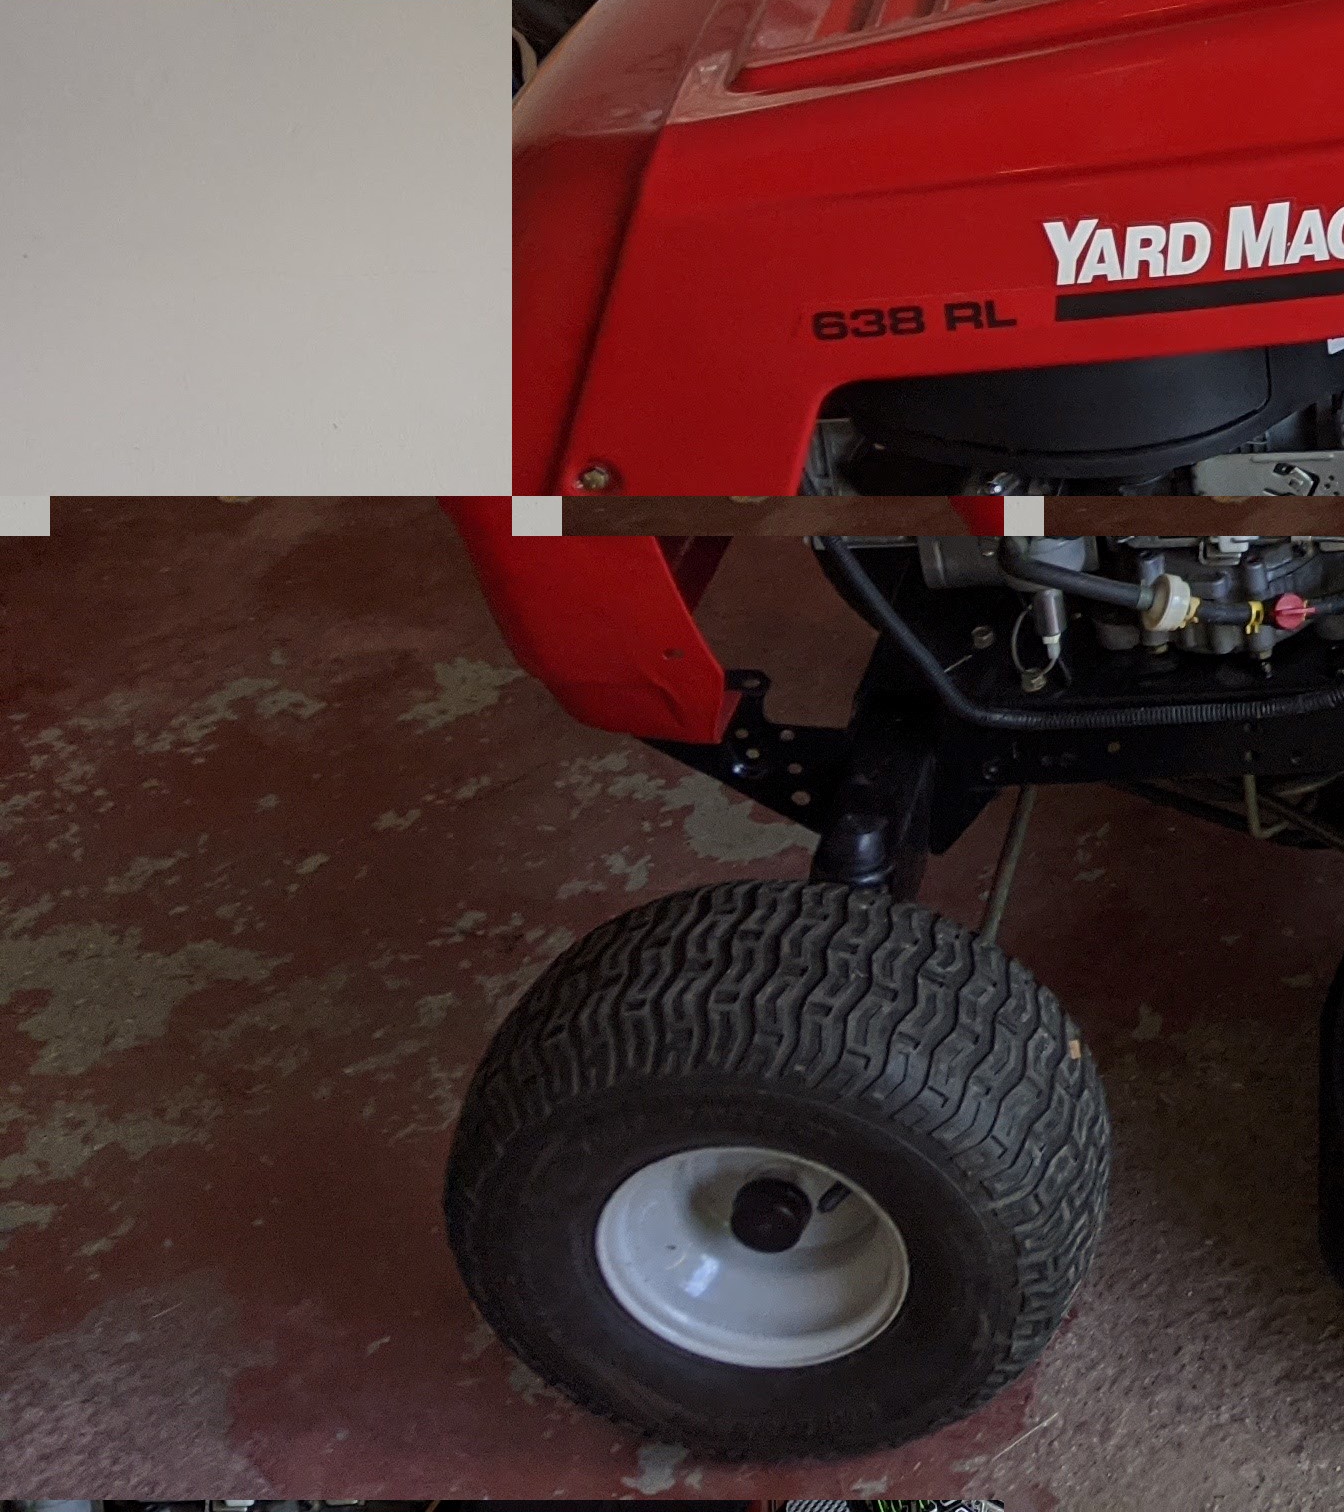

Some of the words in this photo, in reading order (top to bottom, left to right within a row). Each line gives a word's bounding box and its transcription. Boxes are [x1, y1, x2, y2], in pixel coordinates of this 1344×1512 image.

[1043, 217, 1212, 286] YARD
[811, 304, 926, 340] 638
[945, 300, 1018, 333] RL
